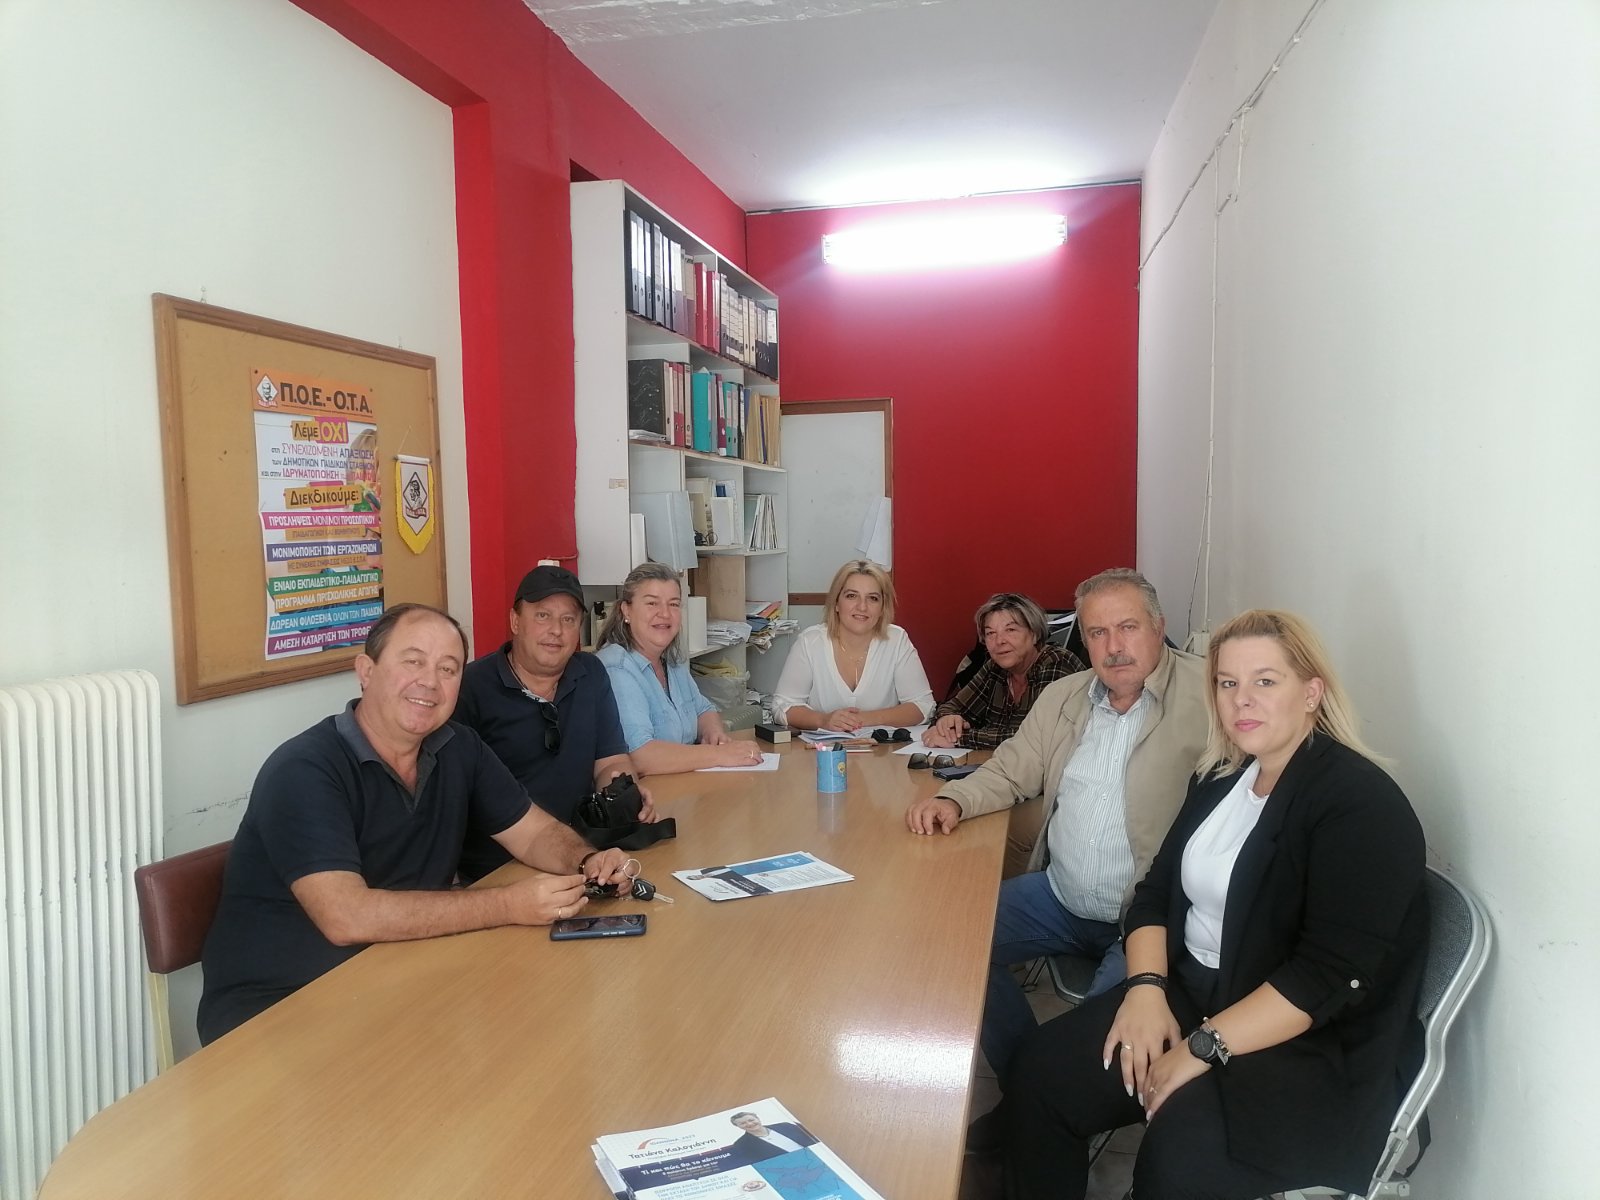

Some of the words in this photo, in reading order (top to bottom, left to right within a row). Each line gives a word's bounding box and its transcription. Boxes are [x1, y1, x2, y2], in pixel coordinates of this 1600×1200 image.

[320, 421, 348, 443] ΟΧΙ
[282, 443, 338, 457] ΣΥΝΕΧΙΖΟΜΕΝΗ
[283, 457, 319, 467] ΔΗΜΟΤΙΚΩΝ
[320, 459, 348, 469] ΠΑΙΔΙΚΩΝ
[282, 468, 340, 479] ΙΔΡΥΜΑΤΟΠΟΙΗΣΗ
[290, 487, 359, 506] Διεκδικούμε:
[269, 515, 312, 526] ΠΡΟΣΛΗΨΕΙΣ
[272, 547, 321, 559] ΜΟΝΙΜΟΠΟΙΗΣΗ
[322, 546, 336, 555] ΤΩΝ
[337, 543, 377, 555] ΕΡΓΑΖΟΜΕΝΩΝ
[273, 581, 296, 592] ΕΝΙΑΙΟ
[297, 573, 379, 589] ΕΚΠΑΙΔΕΥΤΙΚΟ-ΠΑΙΔΑΓΩΓΙΚΟ
[275, 596, 315, 610] ΠΡΟΓΡΑΜΜΑ
[316, 588, 358, 605] ΠΡΟΣΧΟΛΙΚΗΣ
[358, 585, 379, 598] ΑΓΩΓΗΣ
[270, 619, 298, 630] ΔΩΡΕΑΝ
[333, 611, 349, 621] ΟΛΩΝ
[349, 609, 360, 619] ΤΩΝ
[360, 605, 383, 618] ΠΑΙΔΙΩΝ
[274, 638, 300, 651] ΑΜΕΣΗ
[301, 631, 337, 647] ΚΑΤΑΡΓΗΣΗ
[338, 629, 350, 640] ΤΩΝ
[628, 1149, 664, 1160] Τατιάνα
[665, 1138, 717, 1153] Καλογιάννη
